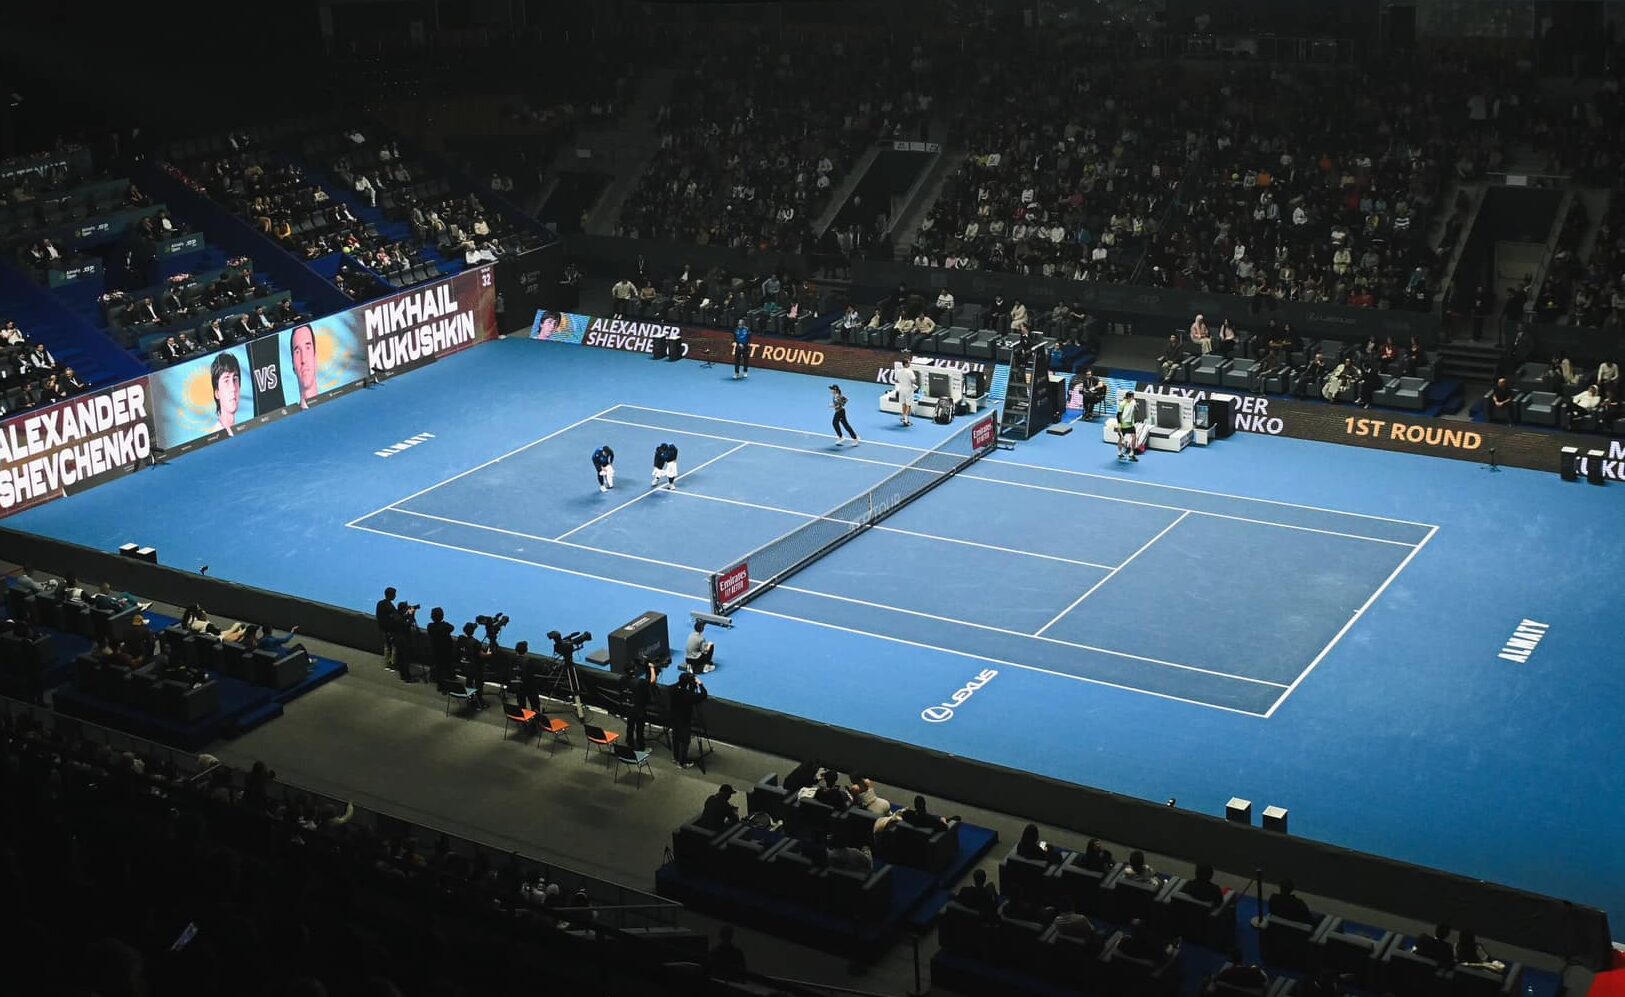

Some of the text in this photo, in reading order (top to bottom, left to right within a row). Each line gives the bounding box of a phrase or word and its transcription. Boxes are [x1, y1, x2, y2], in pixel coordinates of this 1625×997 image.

[481, 272, 492, 287] 32
[364, 284, 459, 340] MIKHAIL
[590, 318, 681, 339] ALEXANDER
[368, 310, 476, 375] KUKUSHKIN
[586, 332, 689, 357] SHEVCHEO
[731, 342, 825, 366] 1T ROUND
[254, 364, 278, 393] VS
[374, 432, 436, 457] ALMATY
[1345, 416, 1482, 450] 1ST ROUND
[719, 570, 747, 592] Emirates
[1497, 618, 1550, 664] ALMATY
[941, 668, 999, 708] LEXUS
